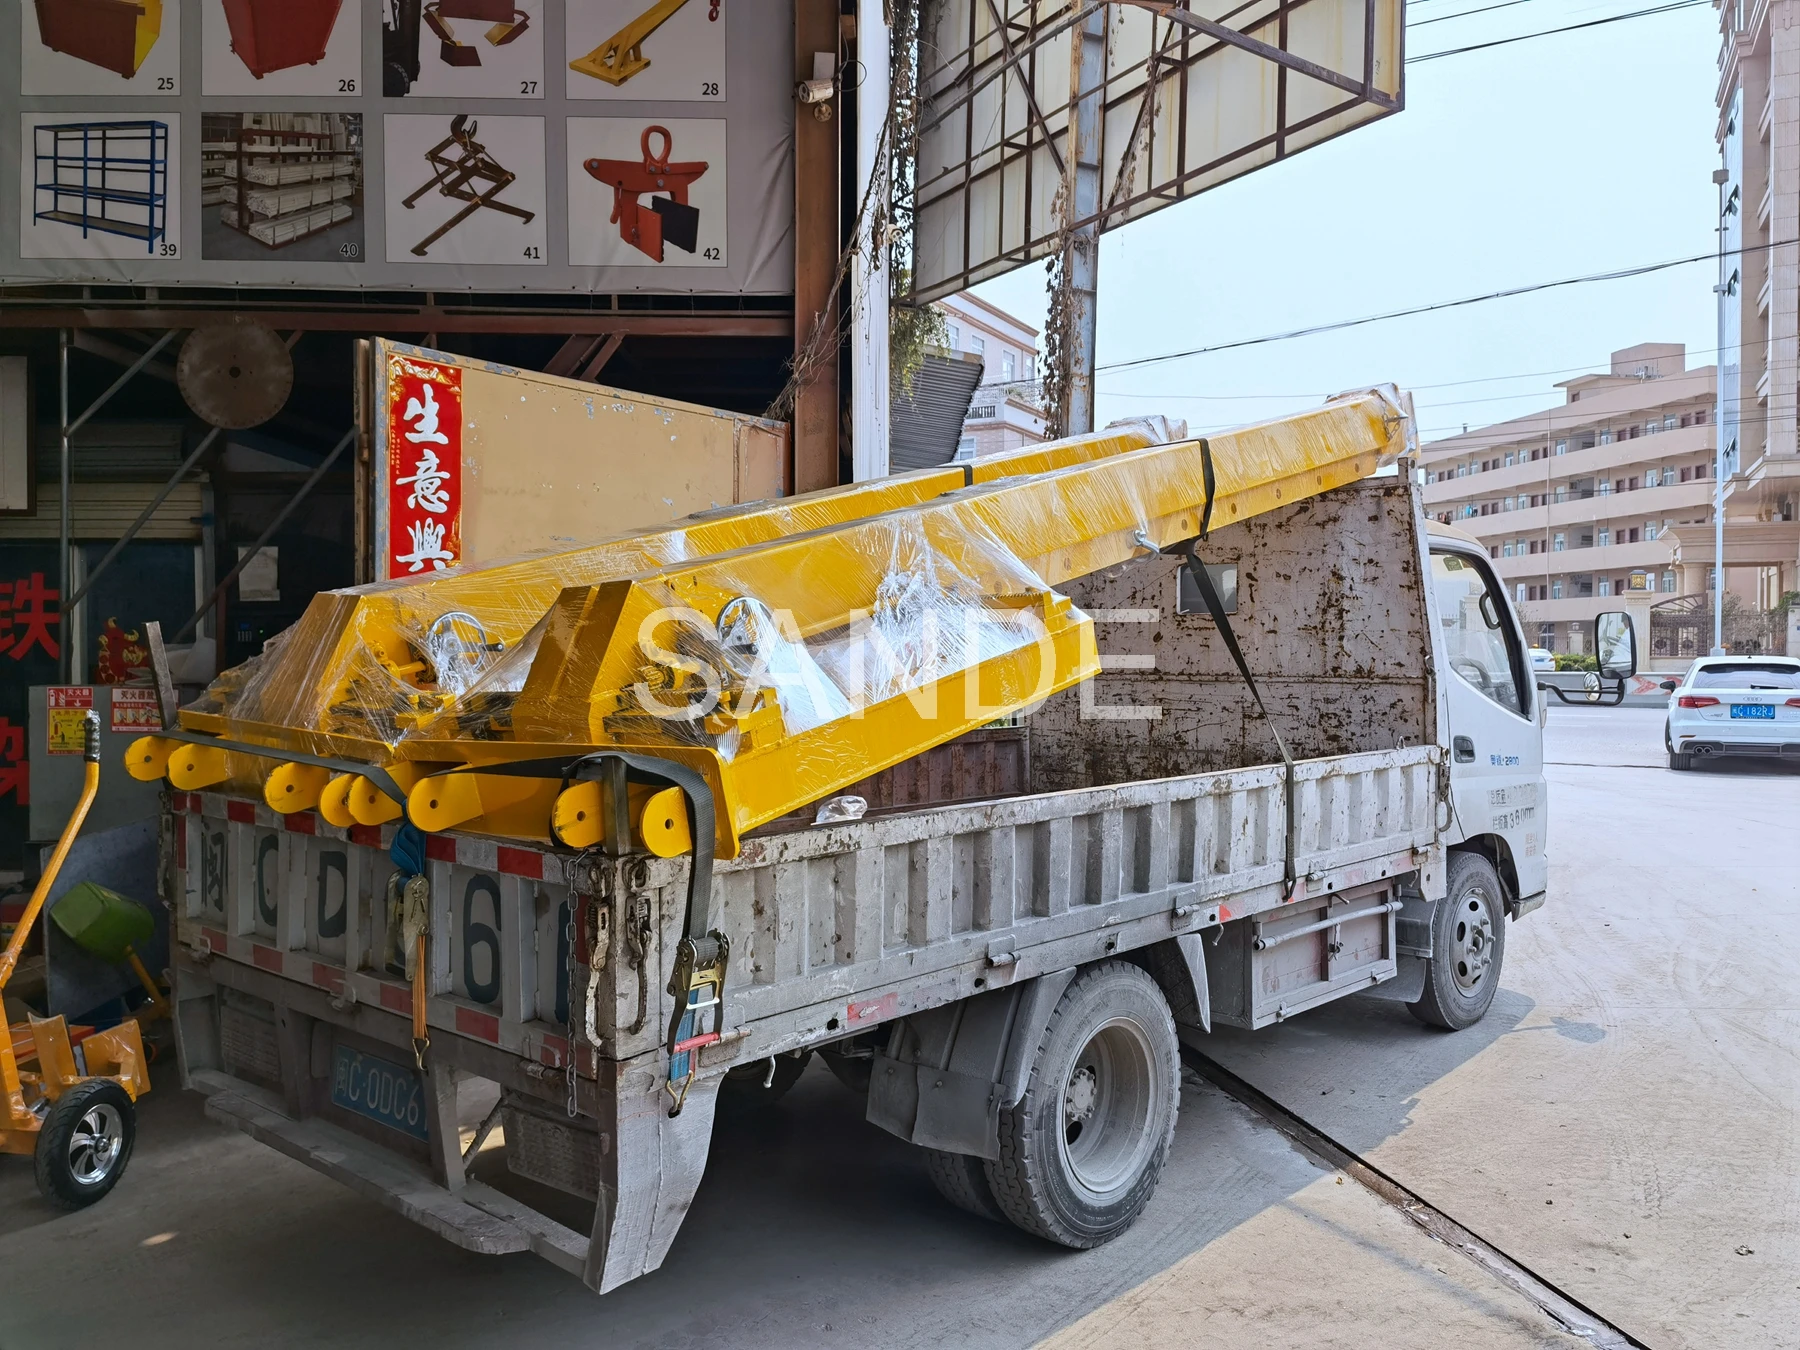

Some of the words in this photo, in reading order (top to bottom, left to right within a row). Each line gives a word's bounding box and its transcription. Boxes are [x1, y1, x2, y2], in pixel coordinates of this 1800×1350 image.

[157, 77, 175, 91] 25
[338, 79, 356, 93] 26
[520, 81, 538, 95] 27
[701, 82, 719, 96] 28
[159, 243, 177, 257] 39
[339, 243, 359, 258] 40
[522, 246, 541, 260] 41
[702, 247, 721, 261] 42
